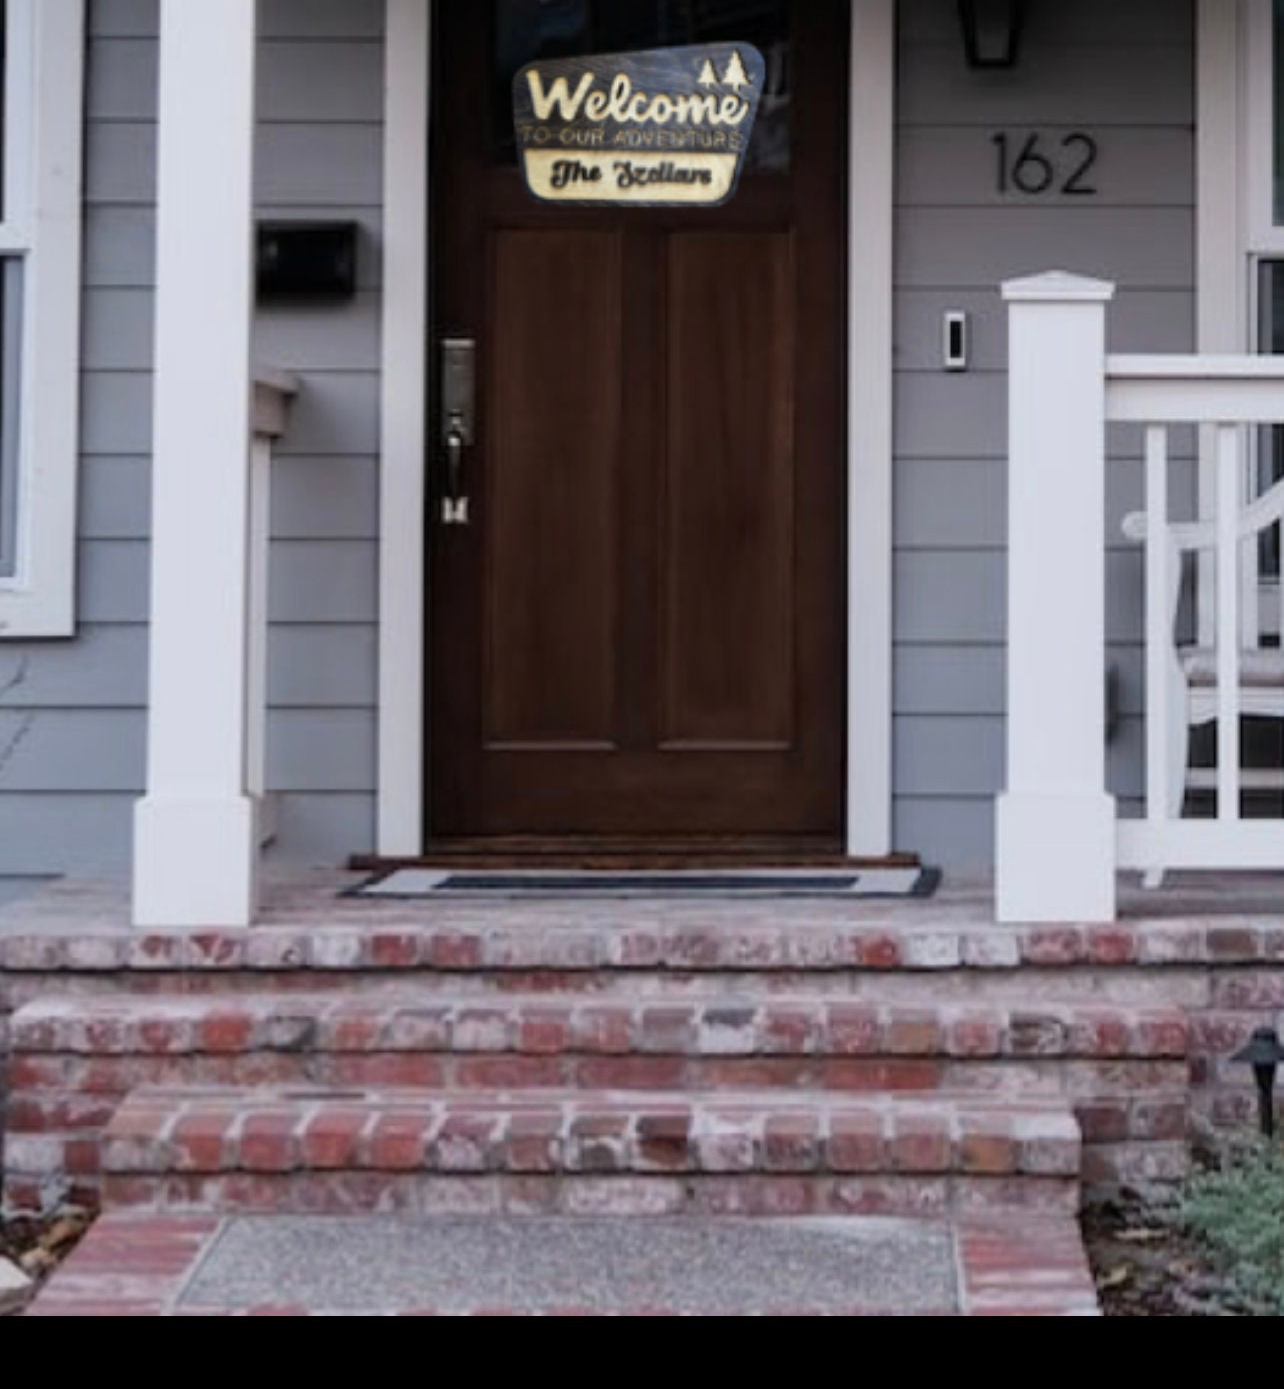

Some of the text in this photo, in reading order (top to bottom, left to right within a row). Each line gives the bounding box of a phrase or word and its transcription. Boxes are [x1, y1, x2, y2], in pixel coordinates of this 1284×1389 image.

[526, 69, 749, 125] Welcome
[522, 126, 743, 149] TO OUR ADVENTURE
[551, 160, 601, 188] The
[991, 132, 1097, 195] 162
